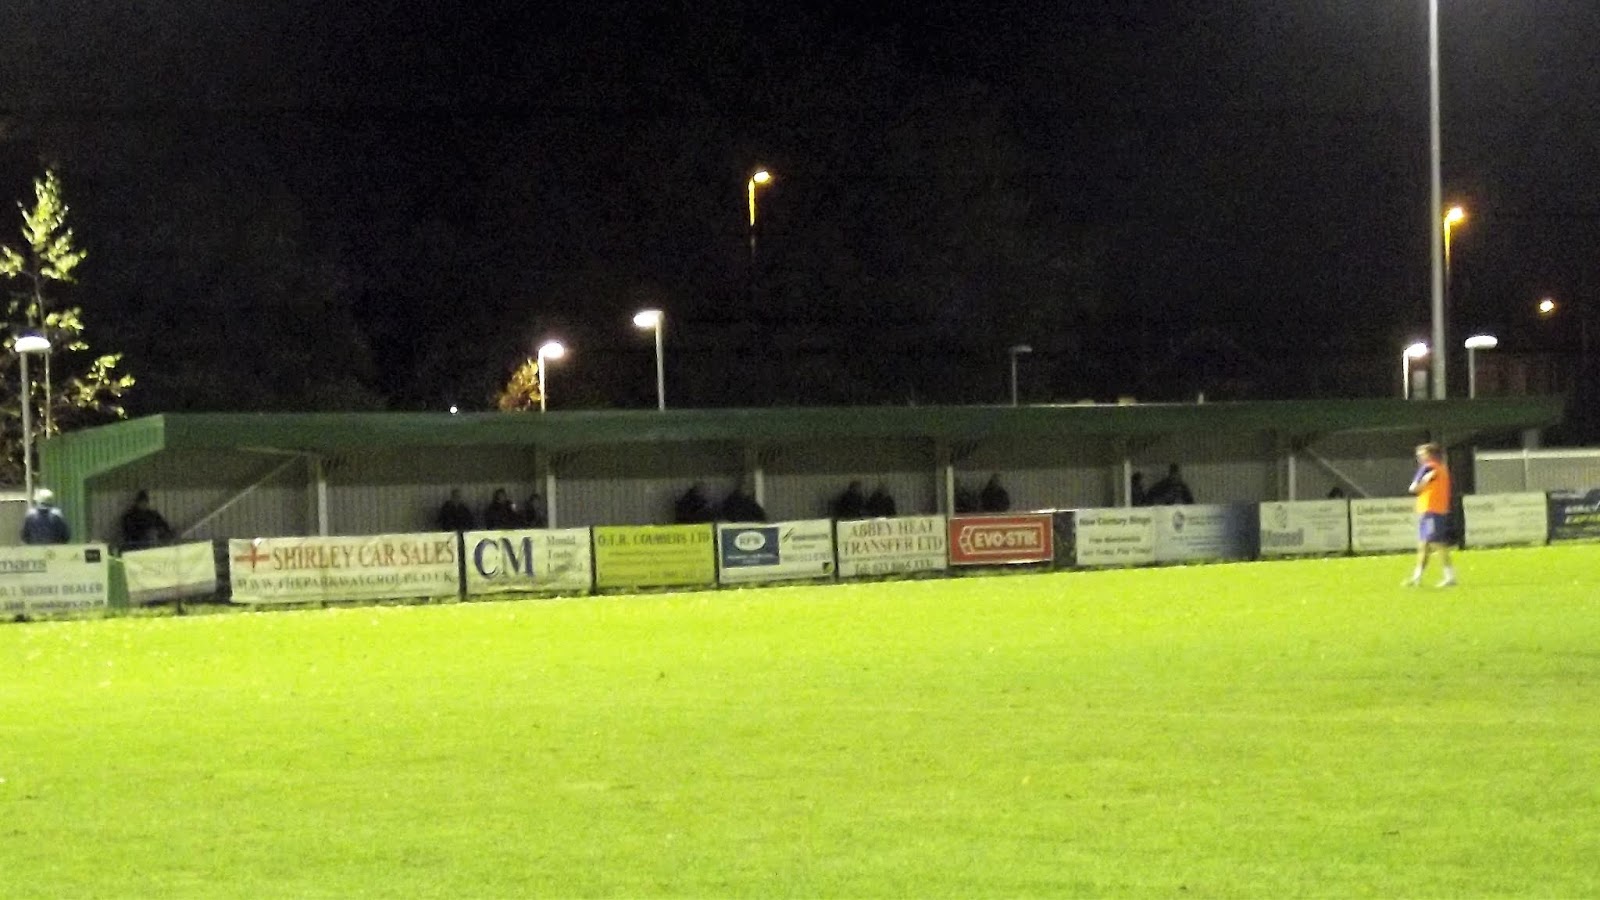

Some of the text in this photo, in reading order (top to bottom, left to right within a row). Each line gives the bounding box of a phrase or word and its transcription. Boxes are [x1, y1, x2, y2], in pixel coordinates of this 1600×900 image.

[898, 520, 933, 534] HEAT
[842, 536, 943, 555] TRANSFER LTD
[974, 530, 1038, 548] EVO-STIK
[274, 540, 455, 570] SHIRLEY CAR SALES
[474, 536, 535, 580] CM
[62, 582, 103, 596] DEALER
